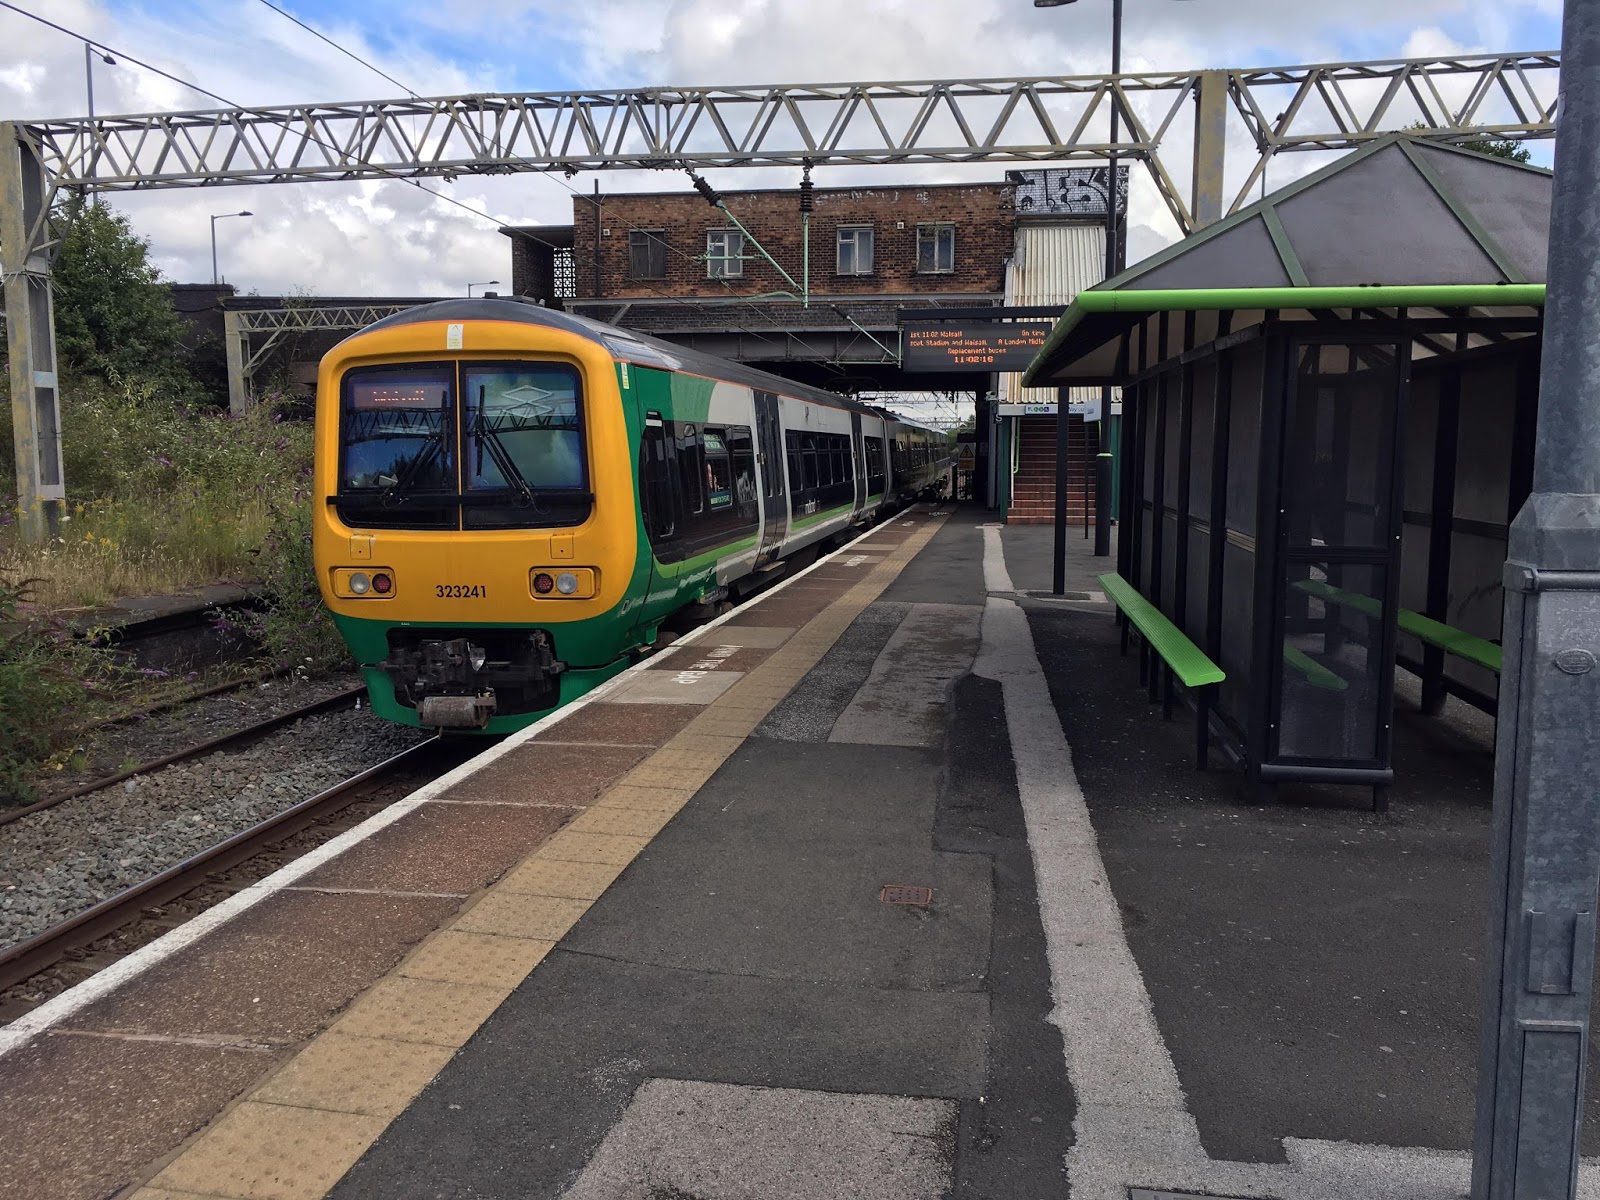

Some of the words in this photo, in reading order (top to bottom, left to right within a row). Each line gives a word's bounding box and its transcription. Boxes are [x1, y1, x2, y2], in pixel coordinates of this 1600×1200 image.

[940, 330, 963, 338] Walsall
[1021, 329, 1030, 337] On
[1031, 329, 1046, 337] time
[1028, 337, 1046, 345] Midla
[947, 347, 986, 355] Replacement
[954, 355, 994, 363] 11:02:16
[435, 584, 486, 598] 323241
[669, 670, 708, 684] GAP
